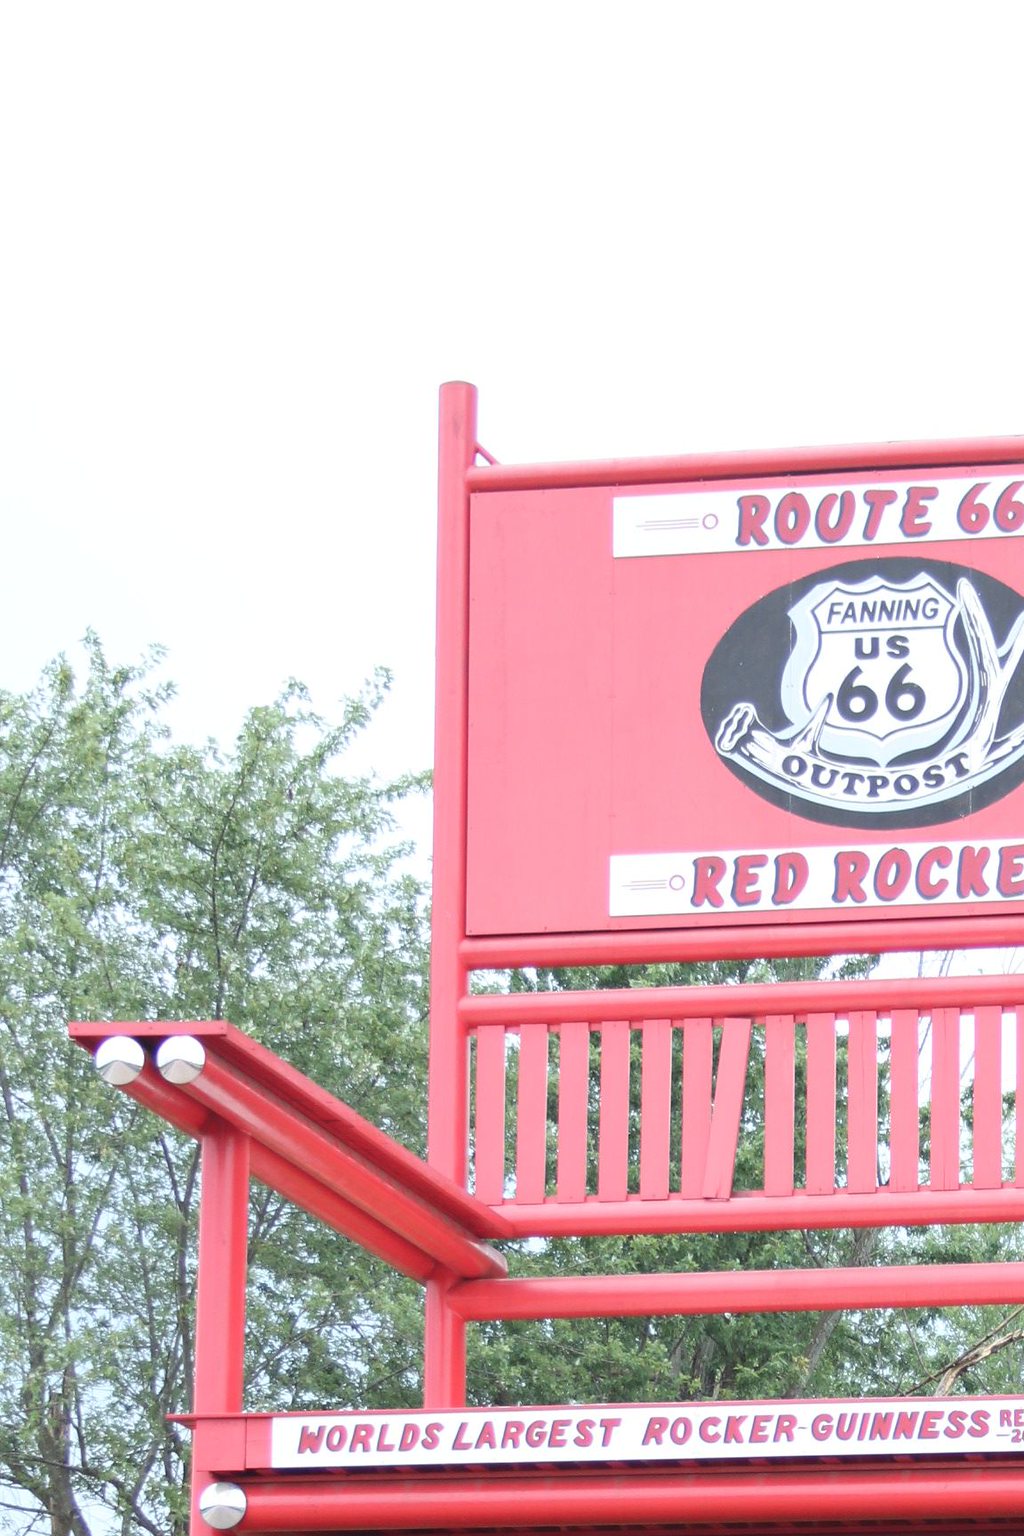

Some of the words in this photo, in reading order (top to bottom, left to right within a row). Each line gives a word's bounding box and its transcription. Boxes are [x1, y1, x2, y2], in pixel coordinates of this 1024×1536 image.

[734, 485, 940, 547] ROUTE
[826, 597, 940, 625] FANNING
[854, 634, 911, 661] US
[836, 662, 927, 723] 66
[781, 752, 970, 798] OUTPOST
[690, 851, 810, 909] RED
[297, 1422, 445, 1455] WORLDS
[451, 1417, 622, 1451] LARGEST
